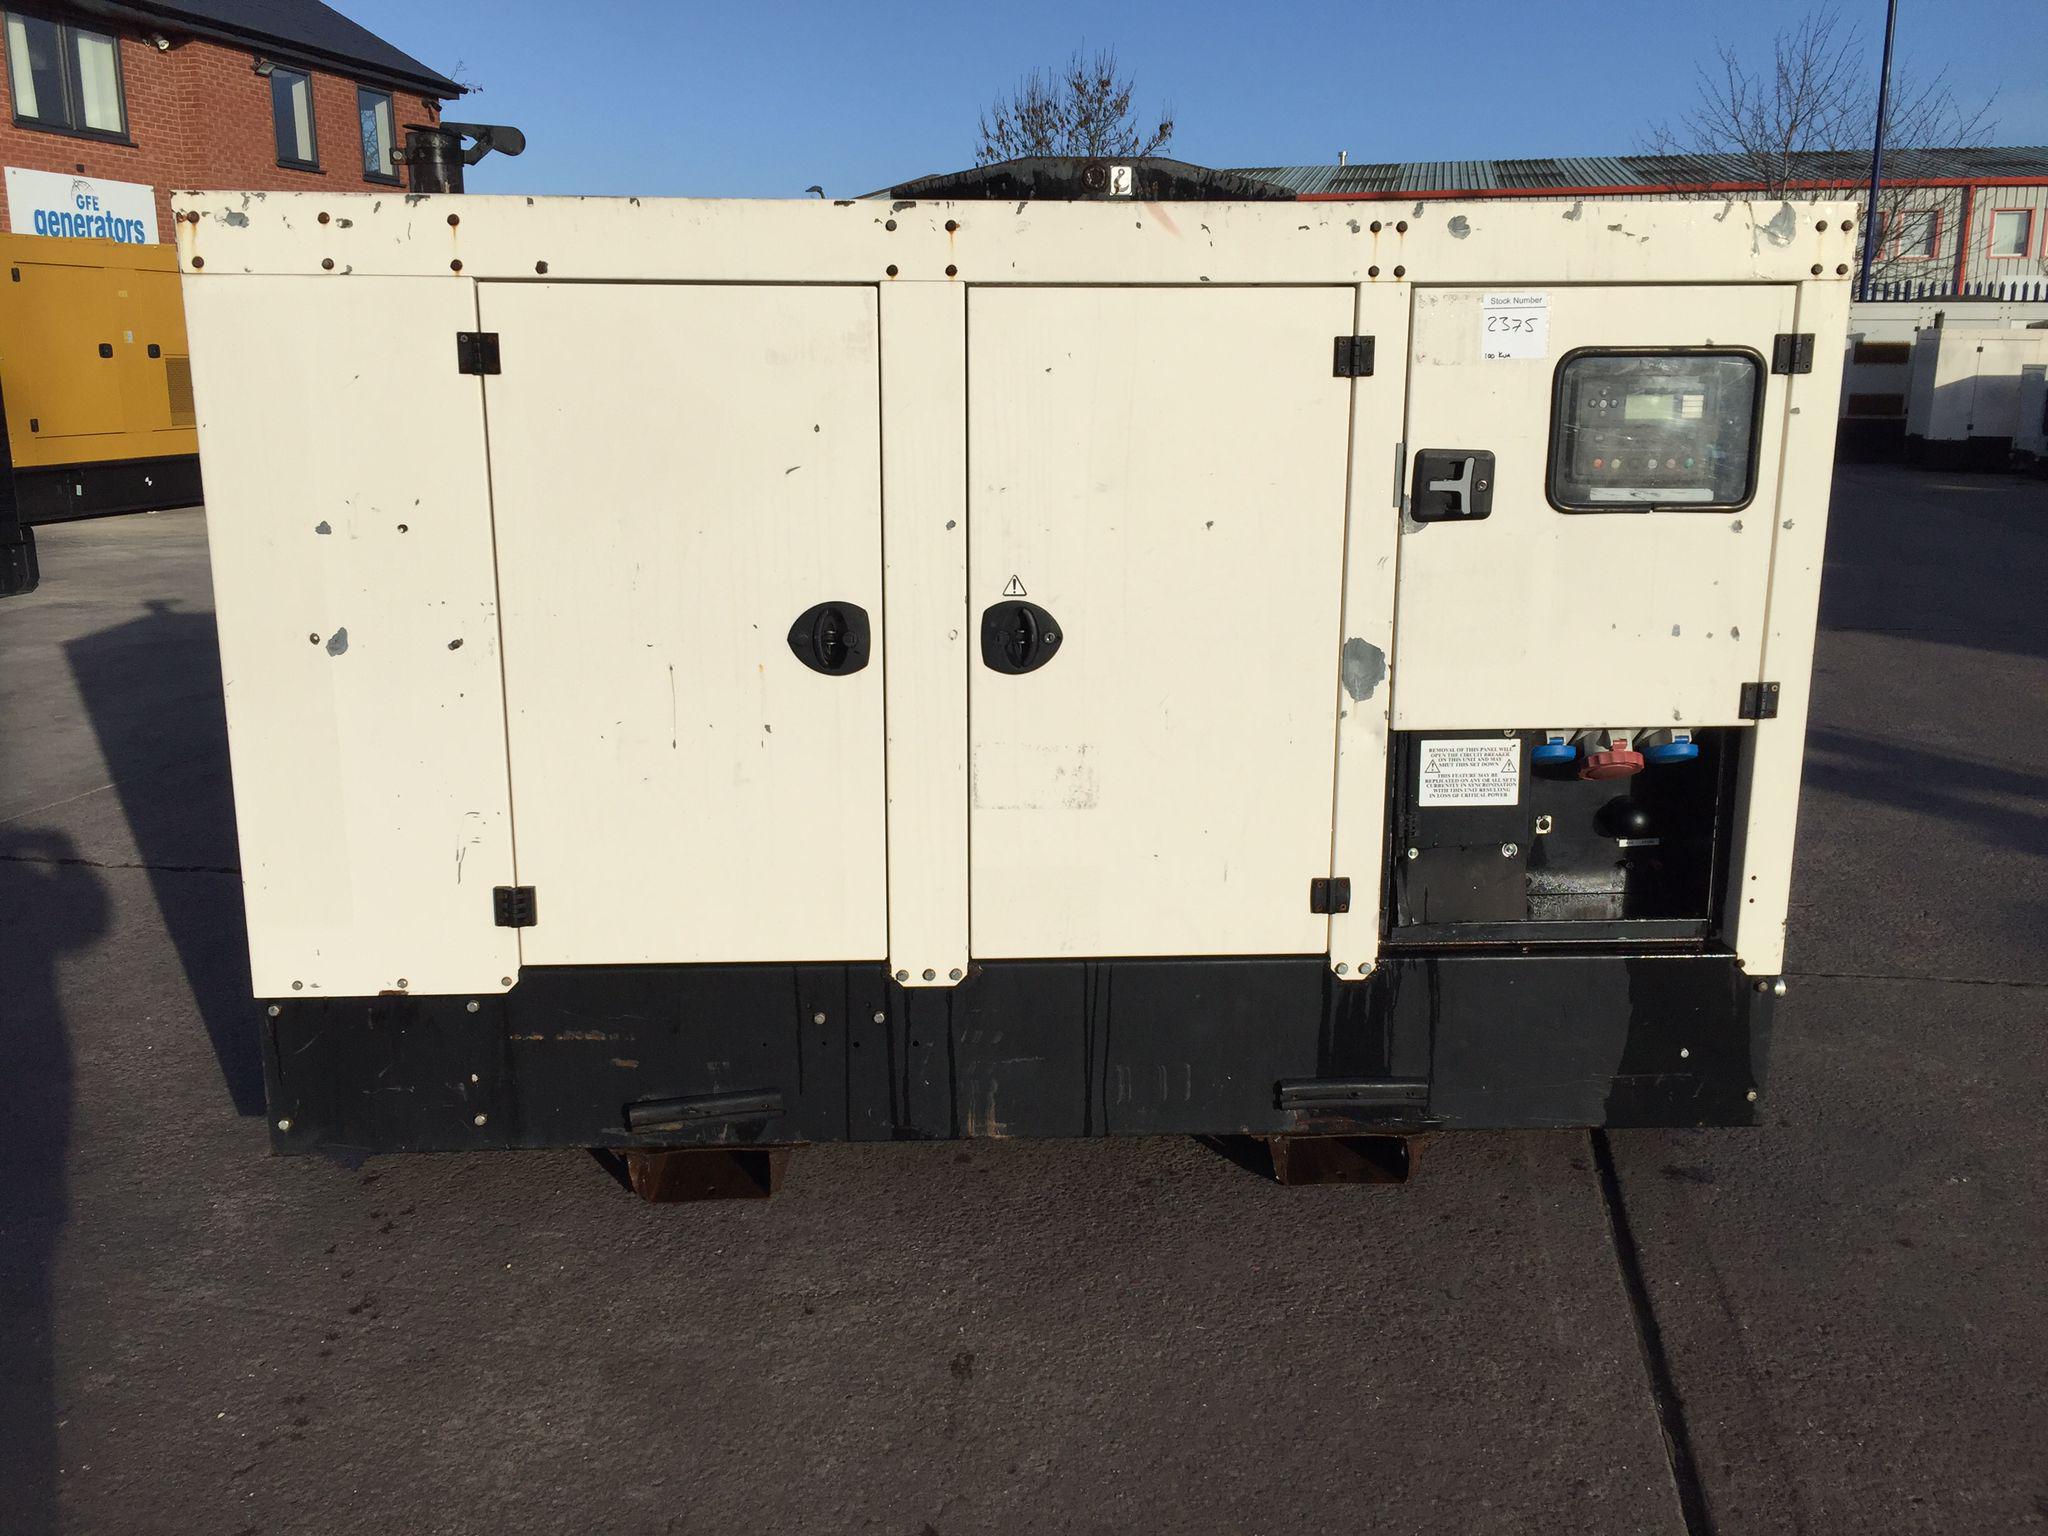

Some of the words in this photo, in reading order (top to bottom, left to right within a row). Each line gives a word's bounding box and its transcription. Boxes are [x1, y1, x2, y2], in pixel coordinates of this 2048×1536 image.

[76, 194, 100, 211] GFE
[34, 209, 145, 244] generators
[1490, 297, 1511, 305] Stock
[1513, 296, 1542, 304] Number
[1488, 316, 1538, 332] 2375
